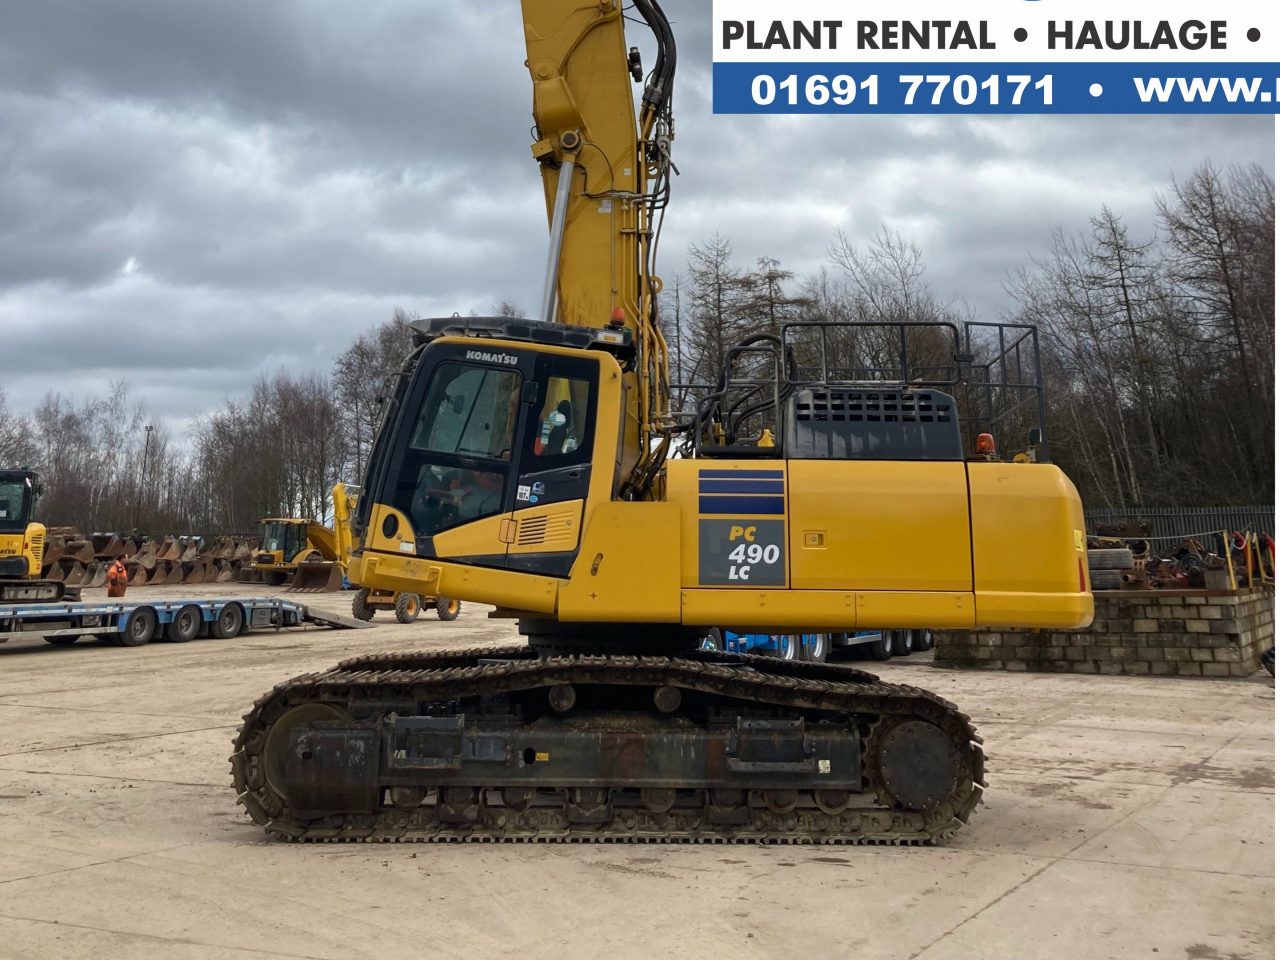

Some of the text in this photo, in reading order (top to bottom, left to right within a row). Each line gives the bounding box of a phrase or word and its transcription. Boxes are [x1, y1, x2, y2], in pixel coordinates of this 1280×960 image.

[466, 350, 518, 365] KOMATSU
[728, 525, 757, 542] PC
[728, 544, 780, 564] 490
[728, 565, 751, 580] LC
